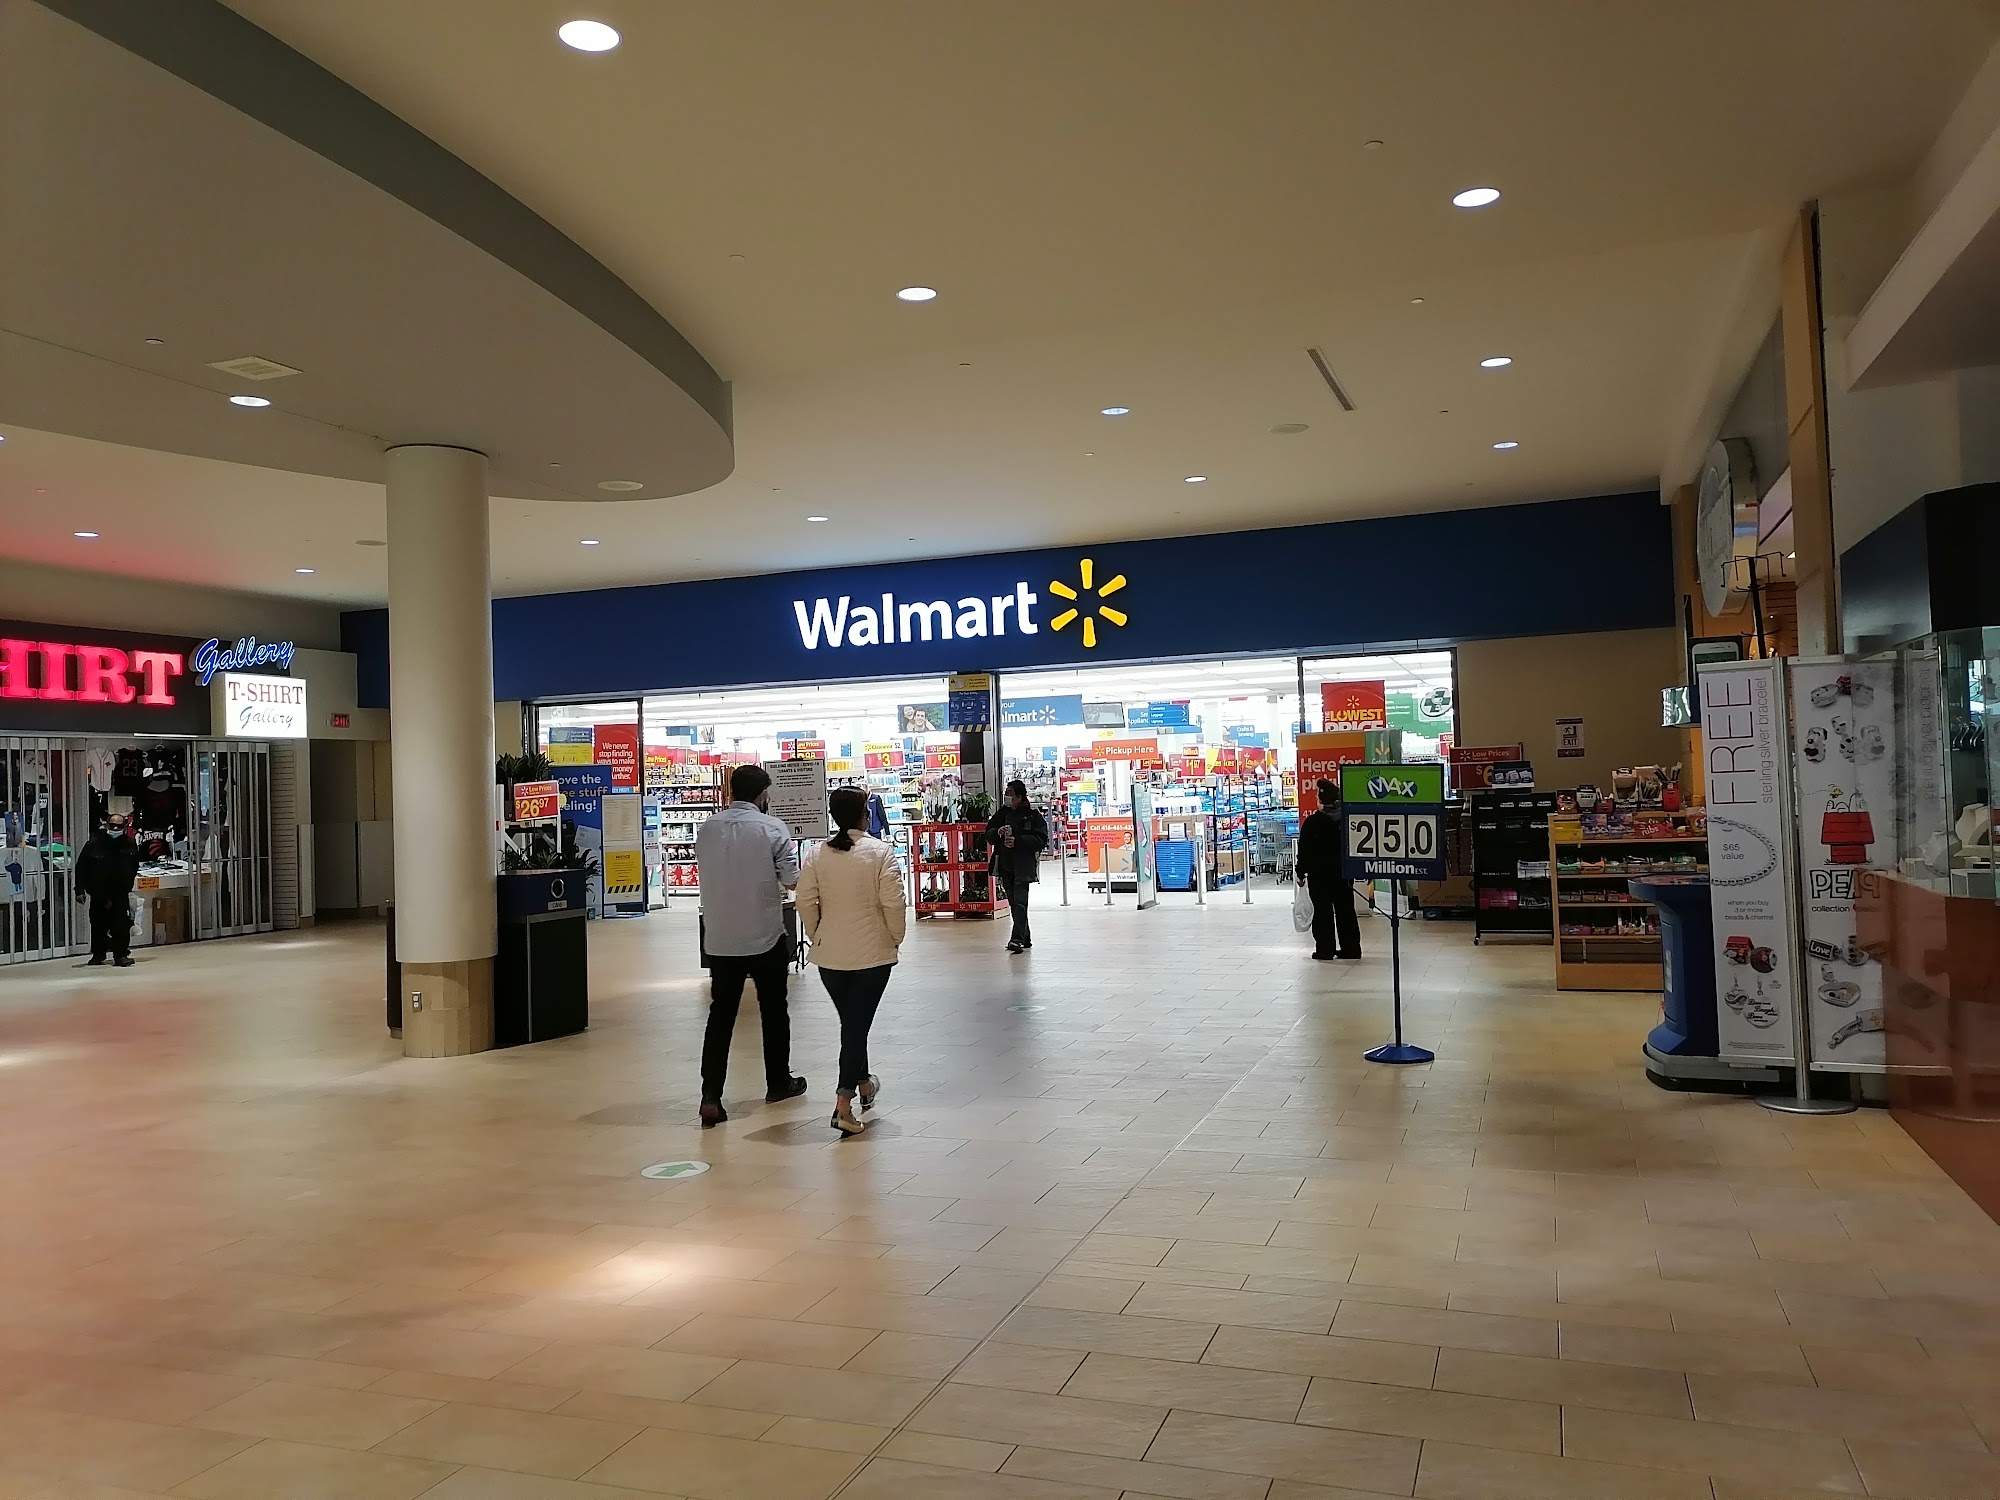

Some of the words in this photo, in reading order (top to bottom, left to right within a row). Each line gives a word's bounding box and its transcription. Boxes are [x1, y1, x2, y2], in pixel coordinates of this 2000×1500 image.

[793, 581, 1038, 650] Walmart
[195, 635, 295, 687] Gallery
[228, 681, 303, 705] T-SHIRT
[1755, 676, 1769, 725] bracelet
[239, 706, 294, 729] Gallery
[1331, 708, 1383, 722] LOWEST
[1563, 738, 1577, 746] EXIT
[1706, 678, 1758, 805] FREE
[1757, 728, 1771, 758] silver
[1106, 746, 1132, 756] Pickup
[1135, 745, 1154, 754] Here
[1472, 750, 1487, 758] Low
[878, 753, 891, 767] $3
[938, 754, 957, 767] $20
[1301, 757, 1336, 773] Here
[122, 758, 138, 777] 23
[612, 766, 633, 774] money
[582, 774, 601, 784] the
[1759, 760, 1774, 804] sterling
[578, 786, 608, 798] stuff
[560, 800, 597, 813] eling!
[1641, 825, 1659, 836] nibs
[1723, 843, 1740, 852] $65
[1721, 852, 1745, 860] value
[1365, 861, 1415, 874] Million
[1812, 904, 1850, 912] collection
[1811, 942, 1831, 956] Love
